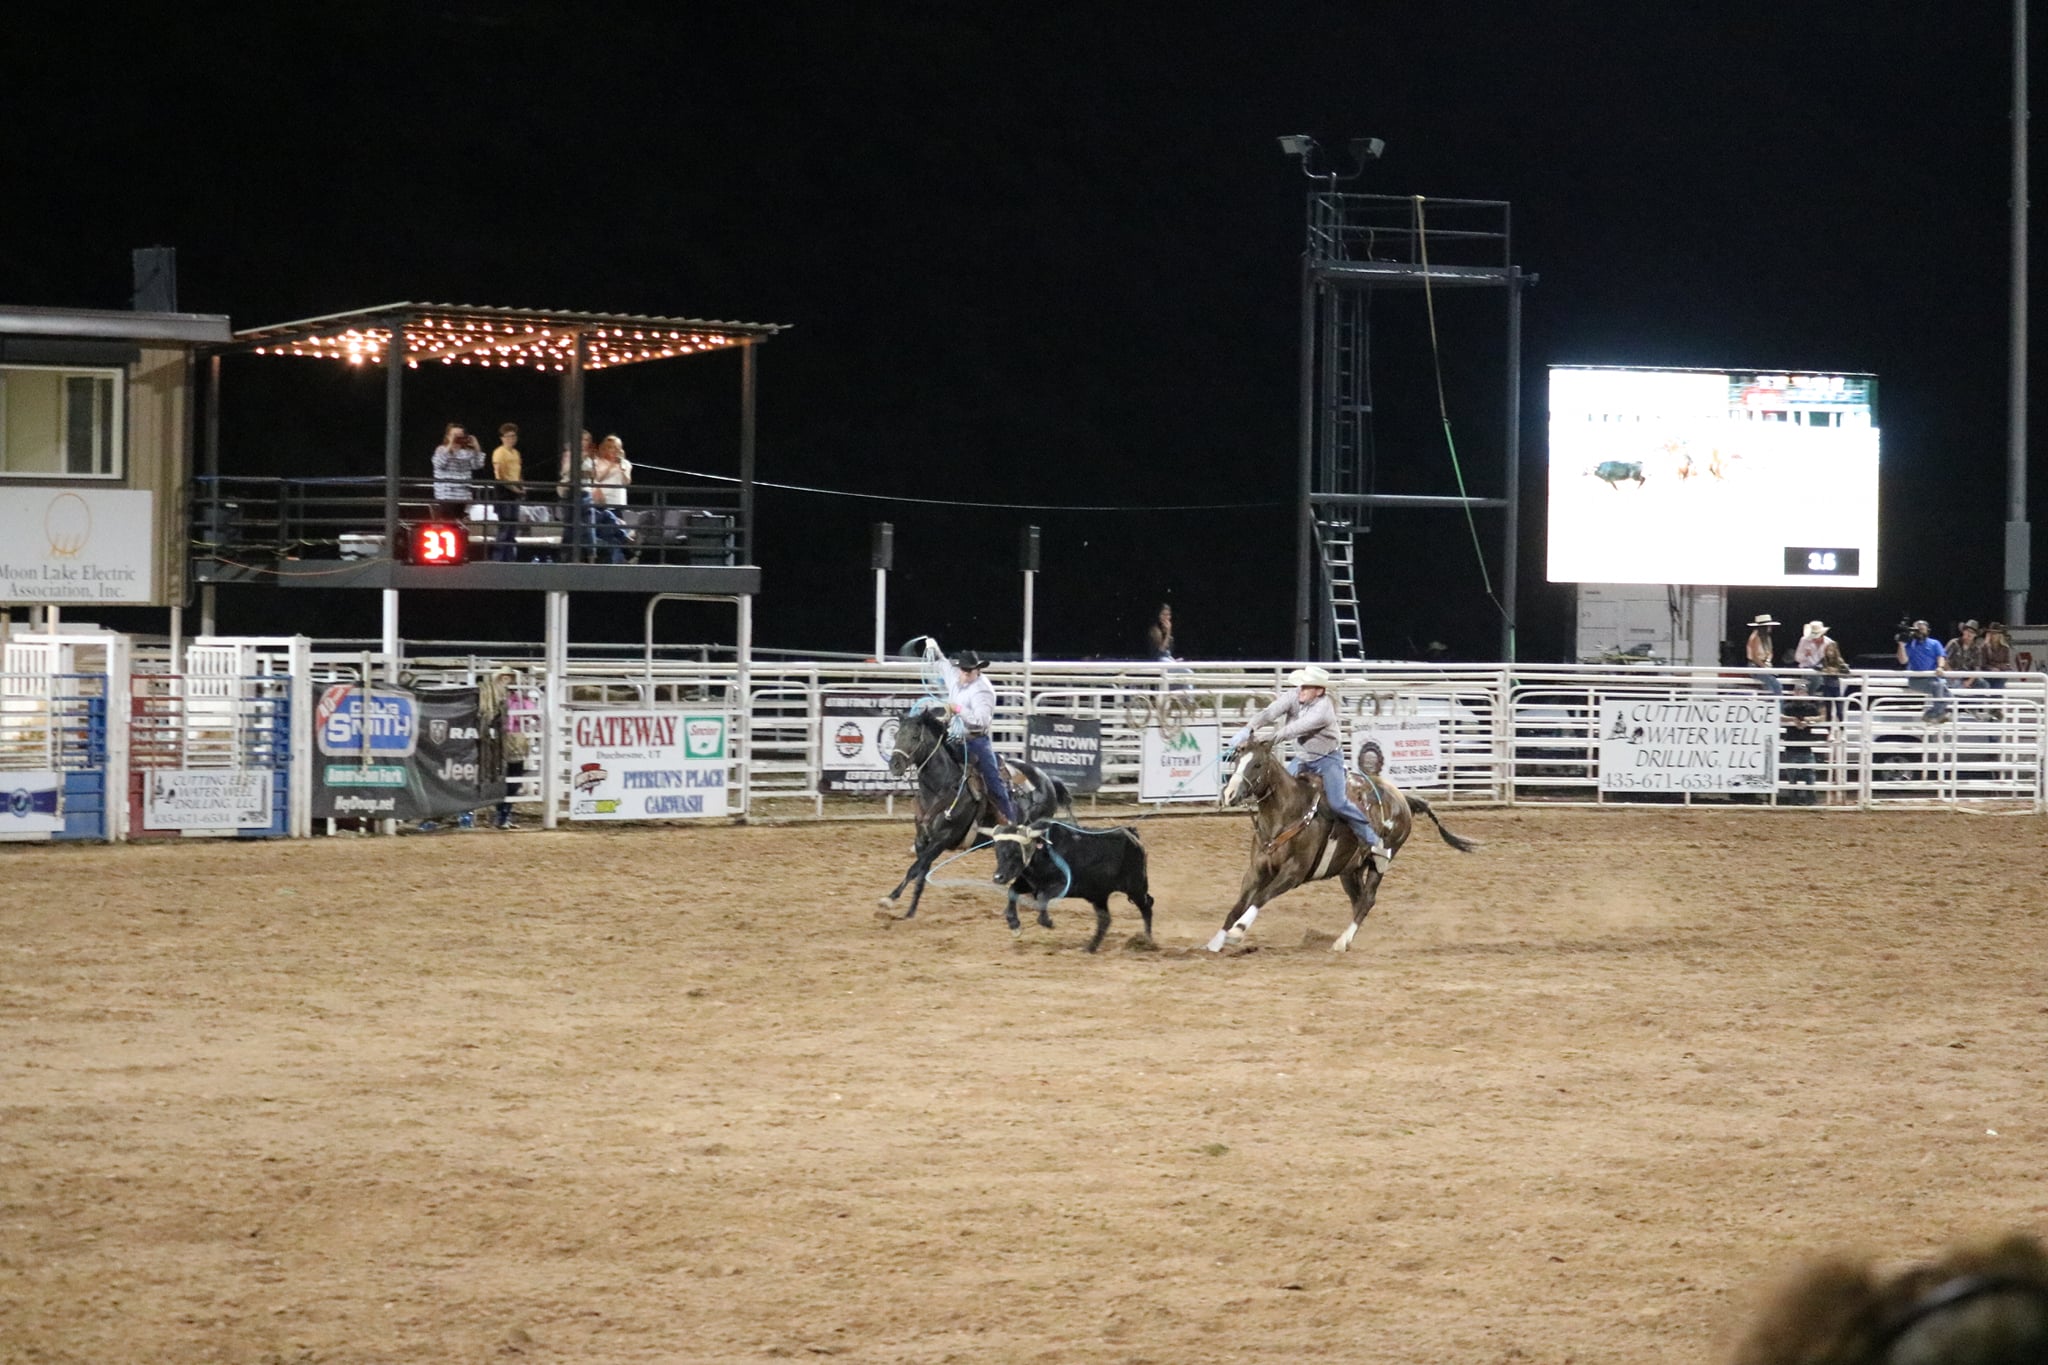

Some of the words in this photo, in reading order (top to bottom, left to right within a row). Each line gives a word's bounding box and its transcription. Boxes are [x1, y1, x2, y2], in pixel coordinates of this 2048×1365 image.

[0, 564, 38, 580] Moon
[42, 564, 78, 580] Lake
[82, 563, 136, 581] Electric
[8, 582, 94, 598] Association,
[98, 582, 126, 598] Inc.
[1632, 704, 1720, 723] CUTTING
[1725, 706, 1776, 724] EDGE
[327, 712, 411, 742] SMITH
[449, 727, 497, 739] RA
[576, 716, 678, 747] GATEWAY
[1647, 726, 1709, 745] WATER
[1713, 727, 1761, 746] WELL
[1030, 734, 1099, 751] HOMETOWN
[1031, 750, 1096, 766] UNIVERSITY
[1727, 751, 1762, 769] LLC
[686, 769, 724, 788] PLACE
[1603, 772, 1725, 790] 435-671-6534
[645, 794, 704, 814] CARWASH
